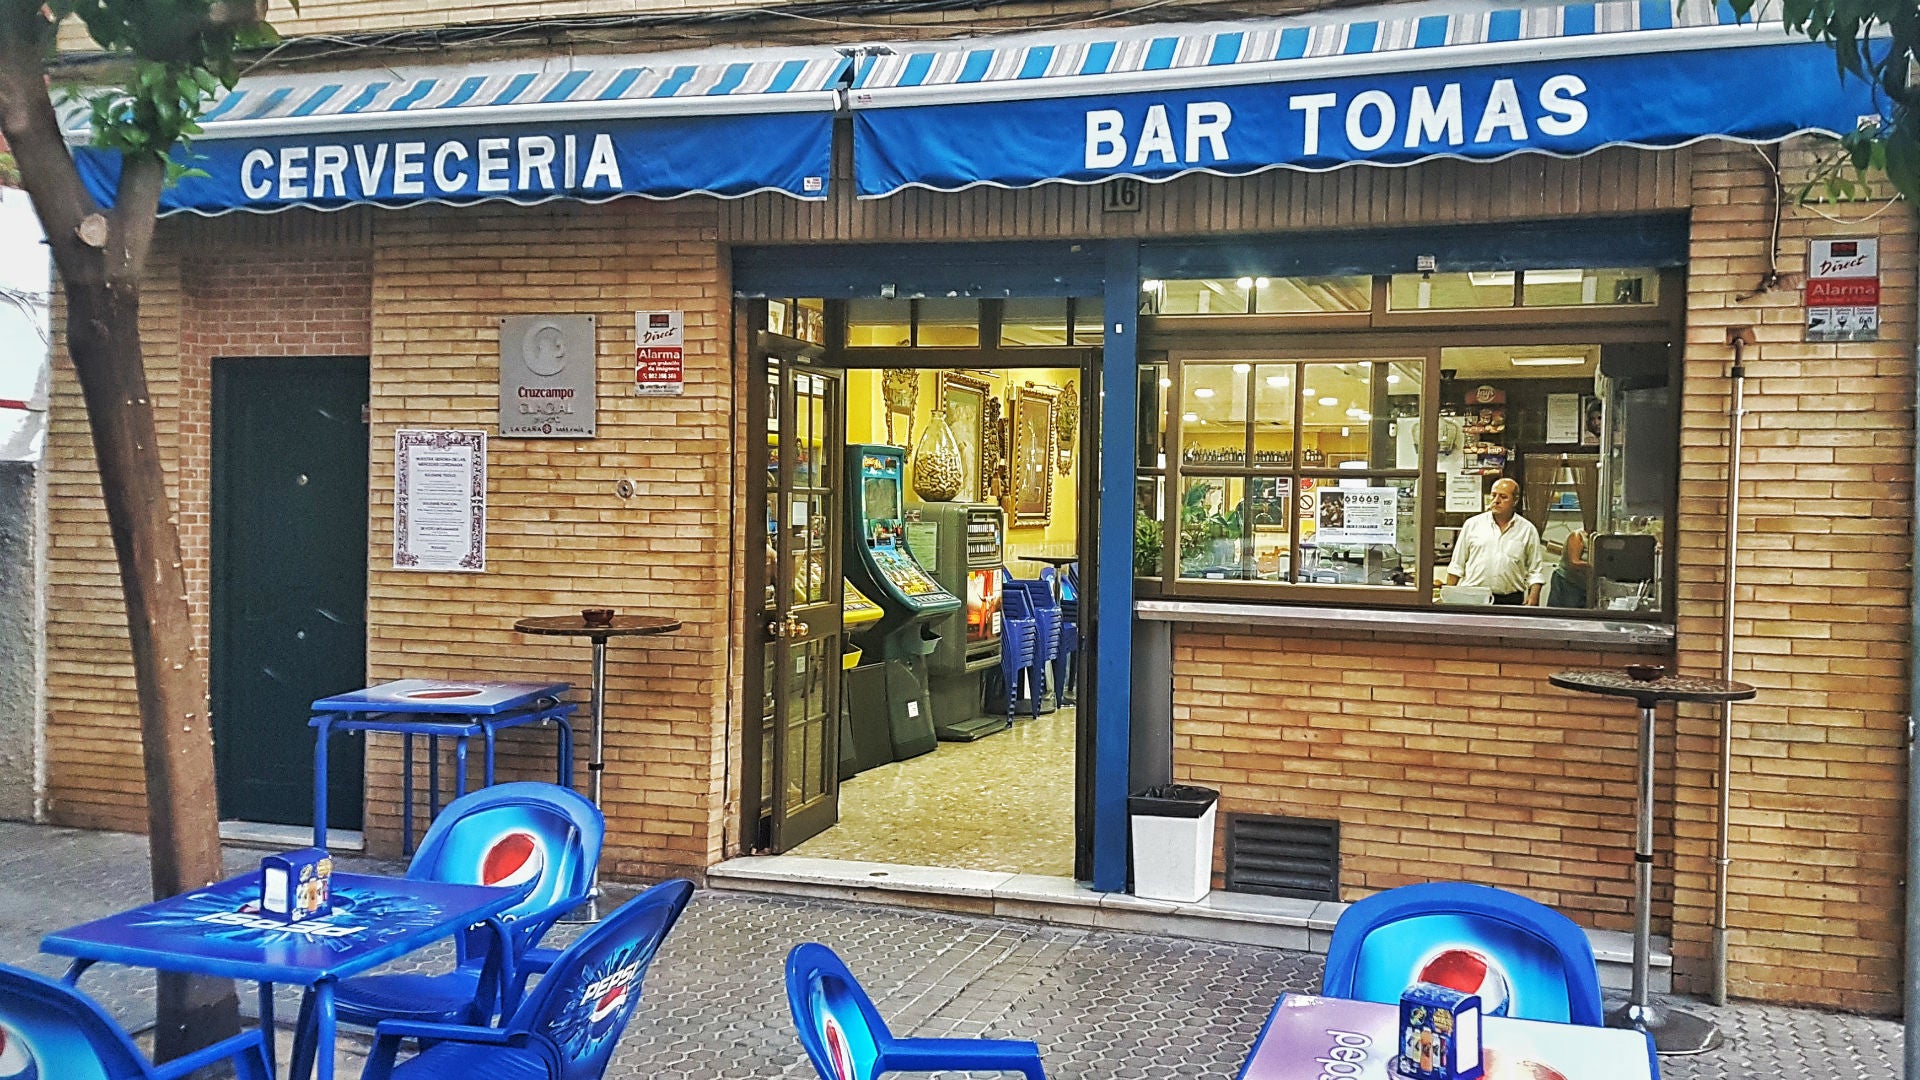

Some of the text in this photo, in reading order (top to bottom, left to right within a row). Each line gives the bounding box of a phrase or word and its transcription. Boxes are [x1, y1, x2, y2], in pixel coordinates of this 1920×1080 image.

[1084, 74, 1589, 170] BAR TOMAS
[241, 134, 623, 199] CERVECERIA
[1109, 179, 1136, 206] 16
[1820, 254, 1869, 276] Direct
[1811, 283, 1876, 297] Alarma
[643, 327, 678, 343] Direct
[638, 349, 680, 359] Alarma
[518, 385, 575, 400] Cruzcampo
[1344, 494, 1380, 504] 69669
[1383, 518, 1394, 526] 22
[579, 960, 641, 1007] PEPSI
